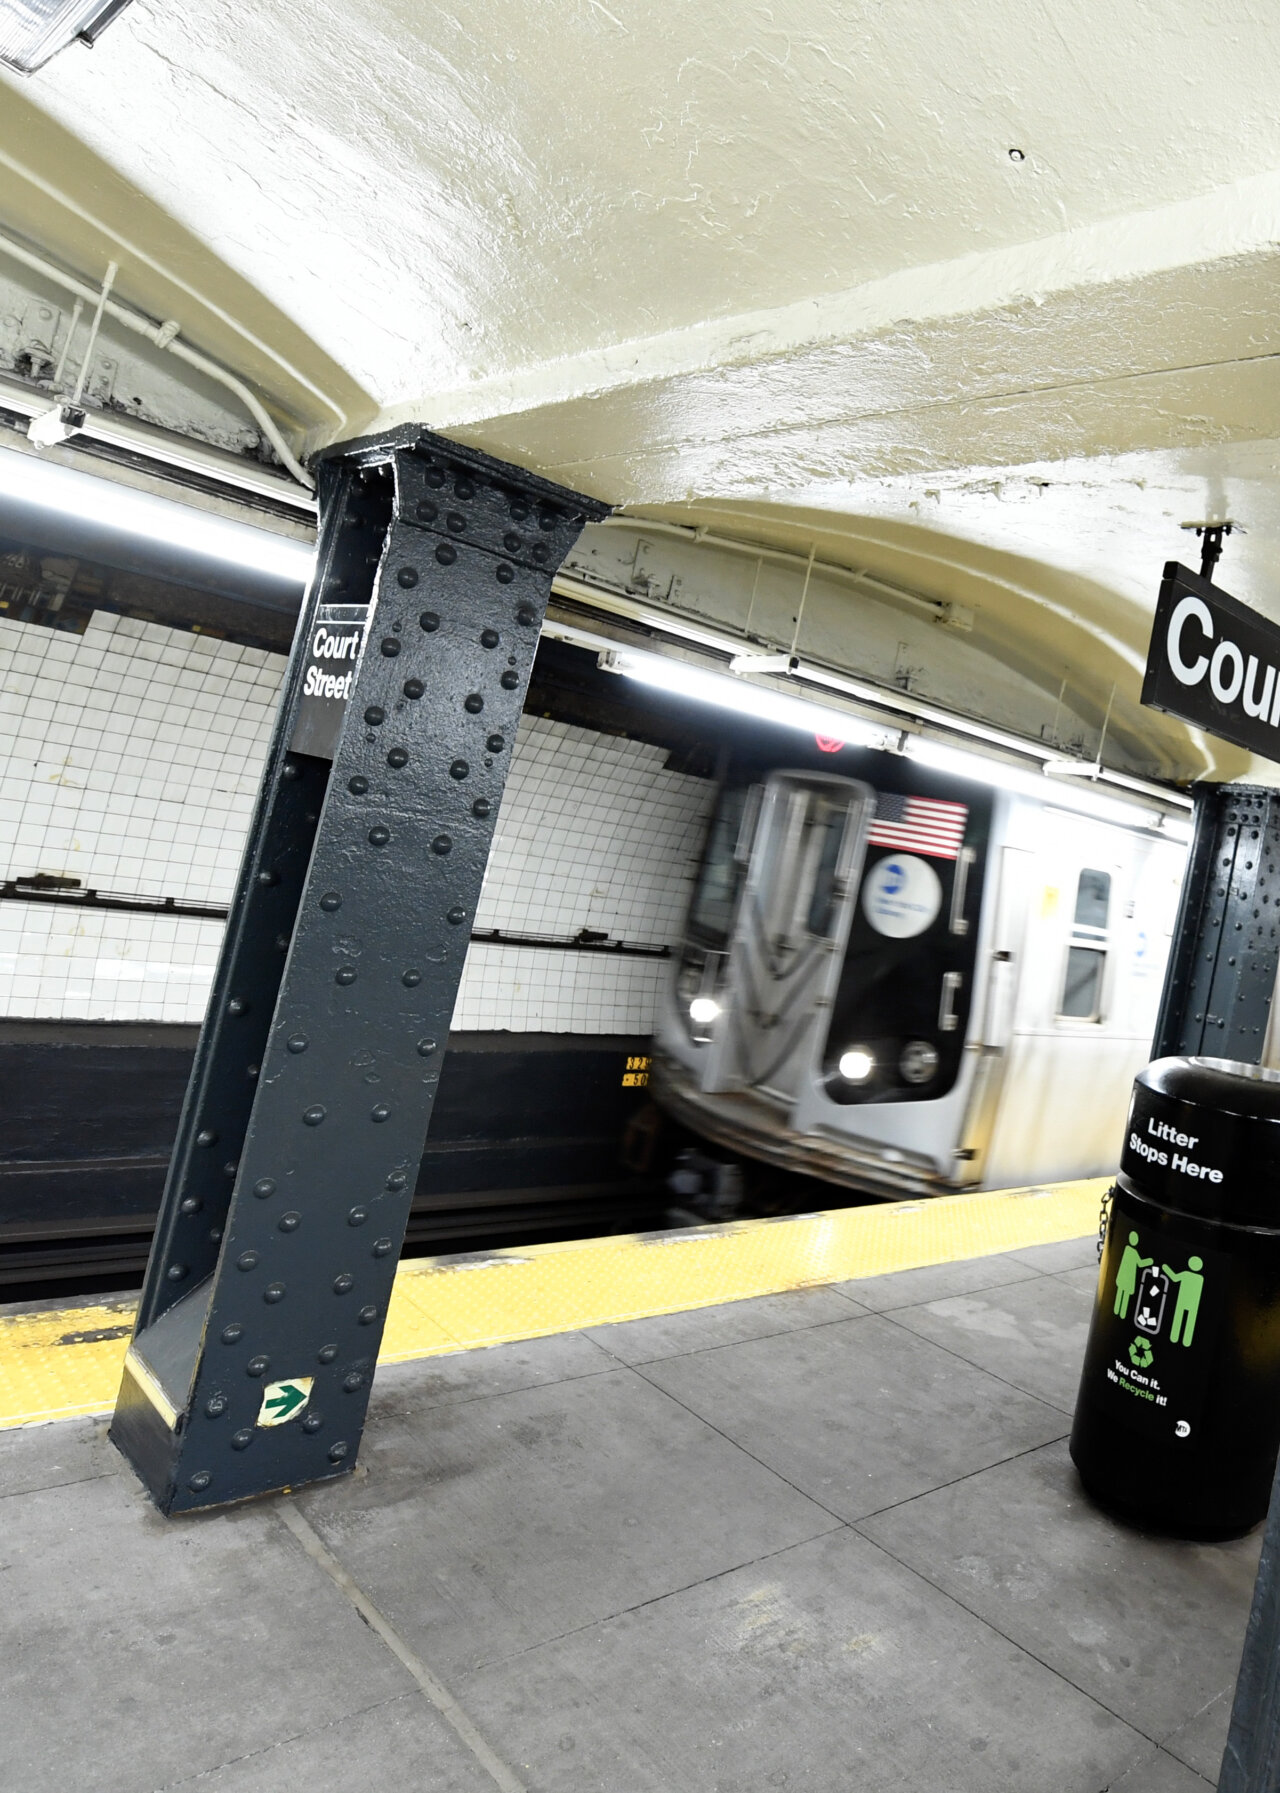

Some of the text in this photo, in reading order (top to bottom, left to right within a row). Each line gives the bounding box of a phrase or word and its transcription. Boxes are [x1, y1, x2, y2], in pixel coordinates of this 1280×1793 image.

[313, 627, 359, 660] Court
[303, 665, 353, 700] Street
[1148, 1117, 1200, 1149] Litter
[1129, 1132, 1224, 1184] Stops Here
[1107, 1368, 1168, 1407] We Recycle it!
[1115, 1359, 1161, 1391] You Can it.
